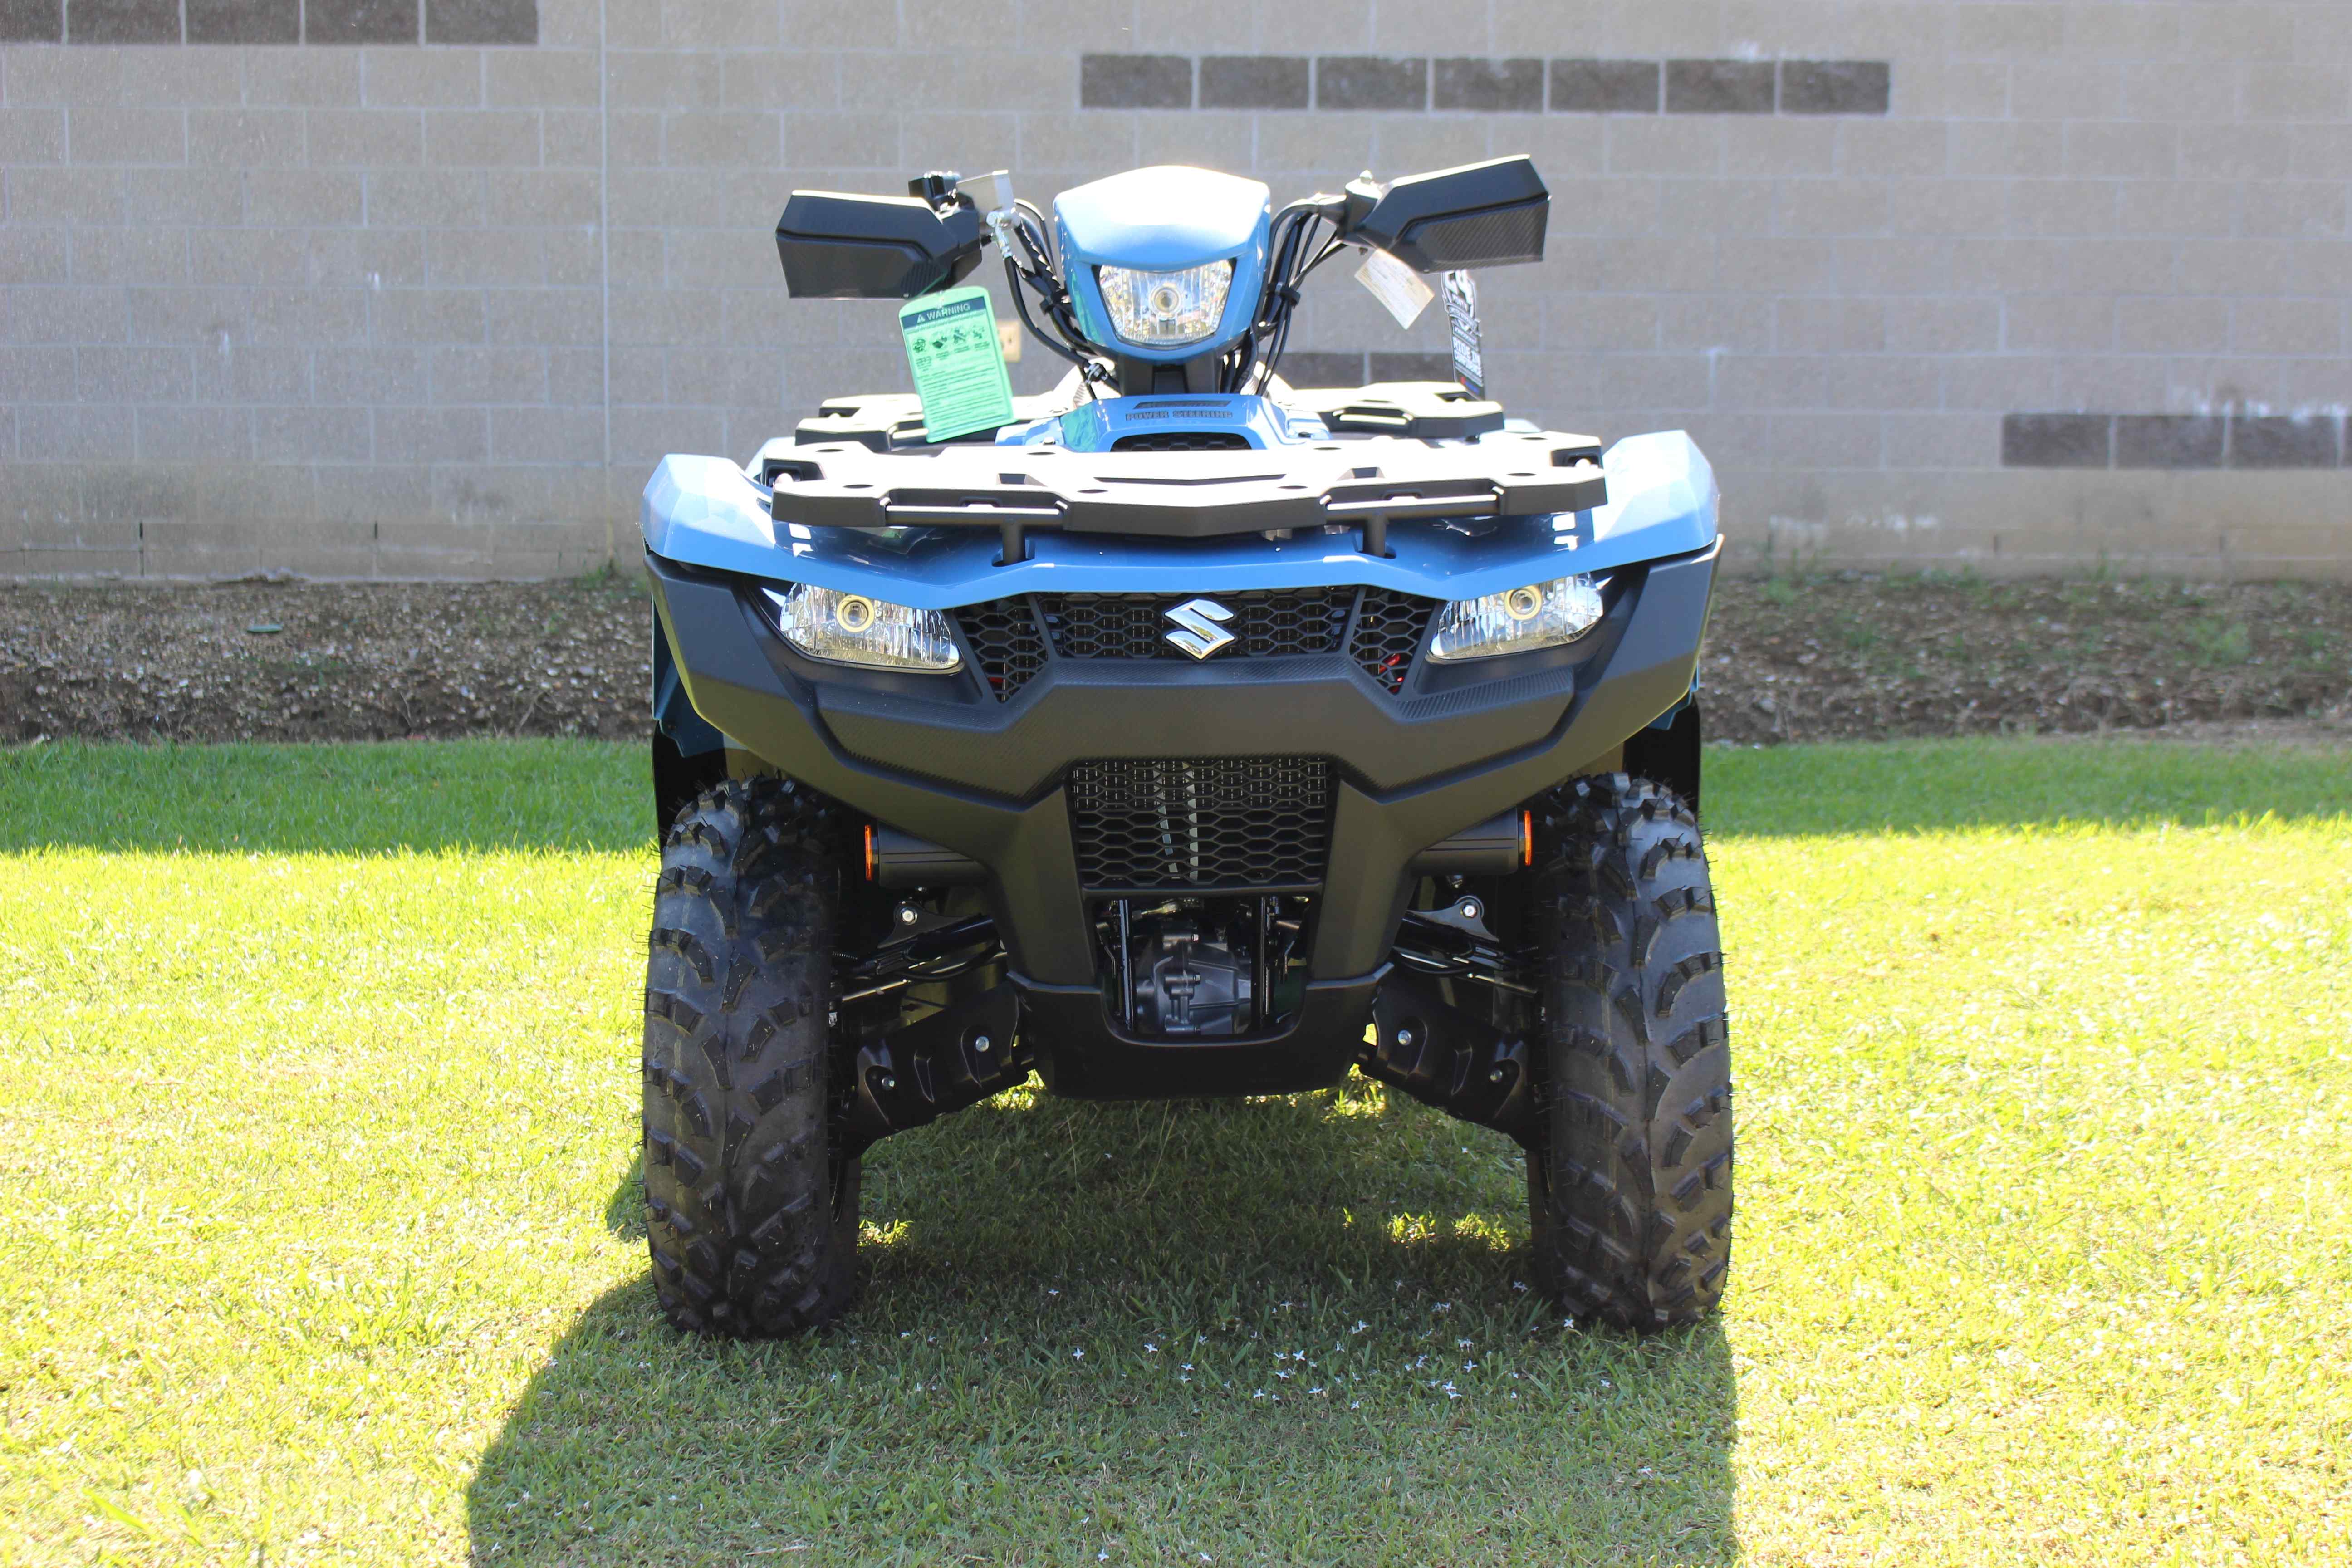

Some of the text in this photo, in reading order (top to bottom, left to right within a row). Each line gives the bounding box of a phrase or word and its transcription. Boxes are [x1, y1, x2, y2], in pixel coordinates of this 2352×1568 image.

[926, 304, 970, 320] WARNING
[1126, 410, 1233, 421] POWER STEERING
